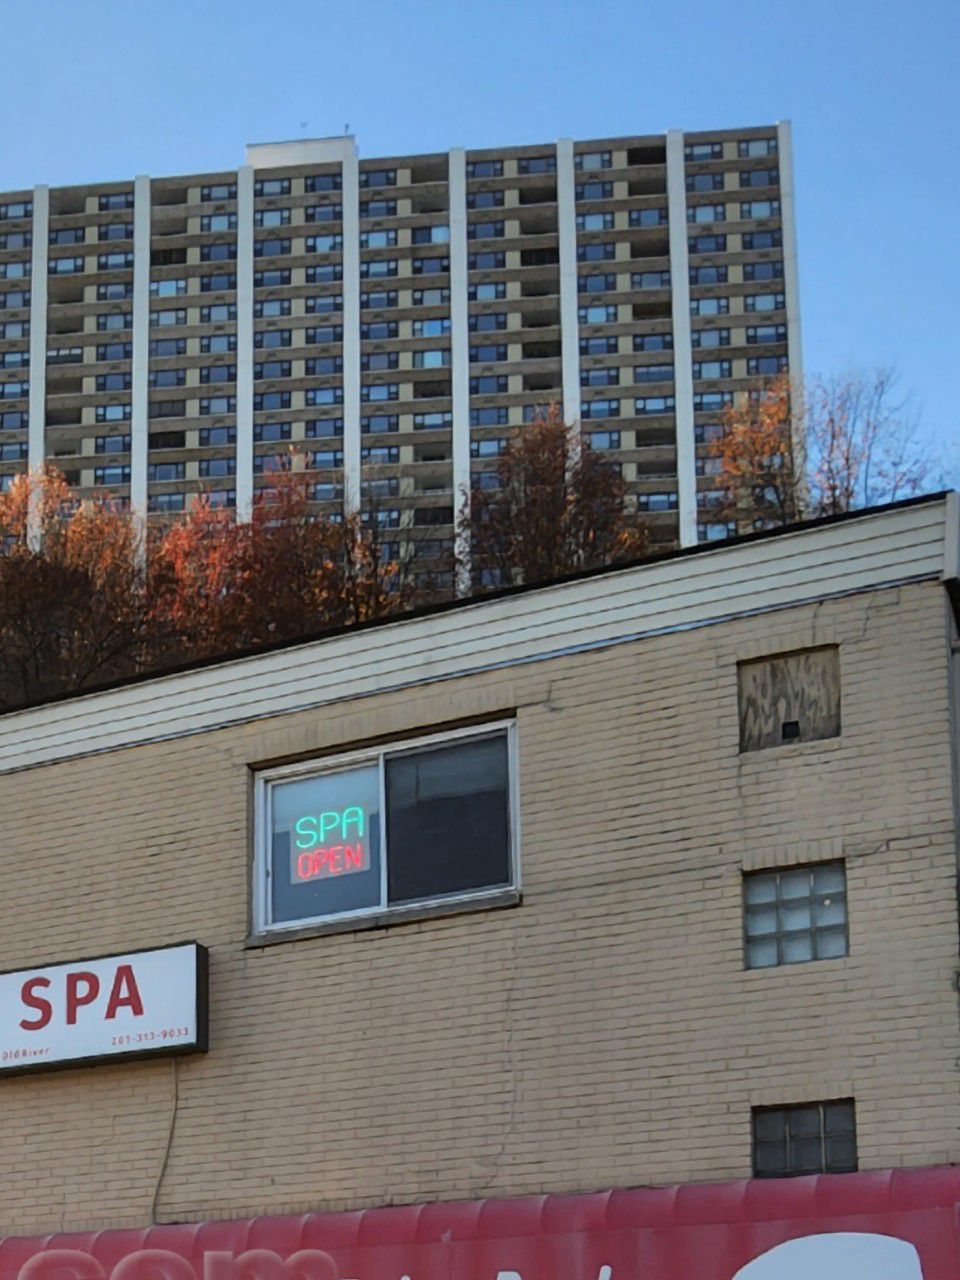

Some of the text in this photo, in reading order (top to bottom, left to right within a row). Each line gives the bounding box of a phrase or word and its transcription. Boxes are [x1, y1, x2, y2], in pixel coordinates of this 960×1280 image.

[295, 806, 364, 848] SPA
[297, 844, 361, 878] OPEN
[19, 964, 144, 1031] SPA
